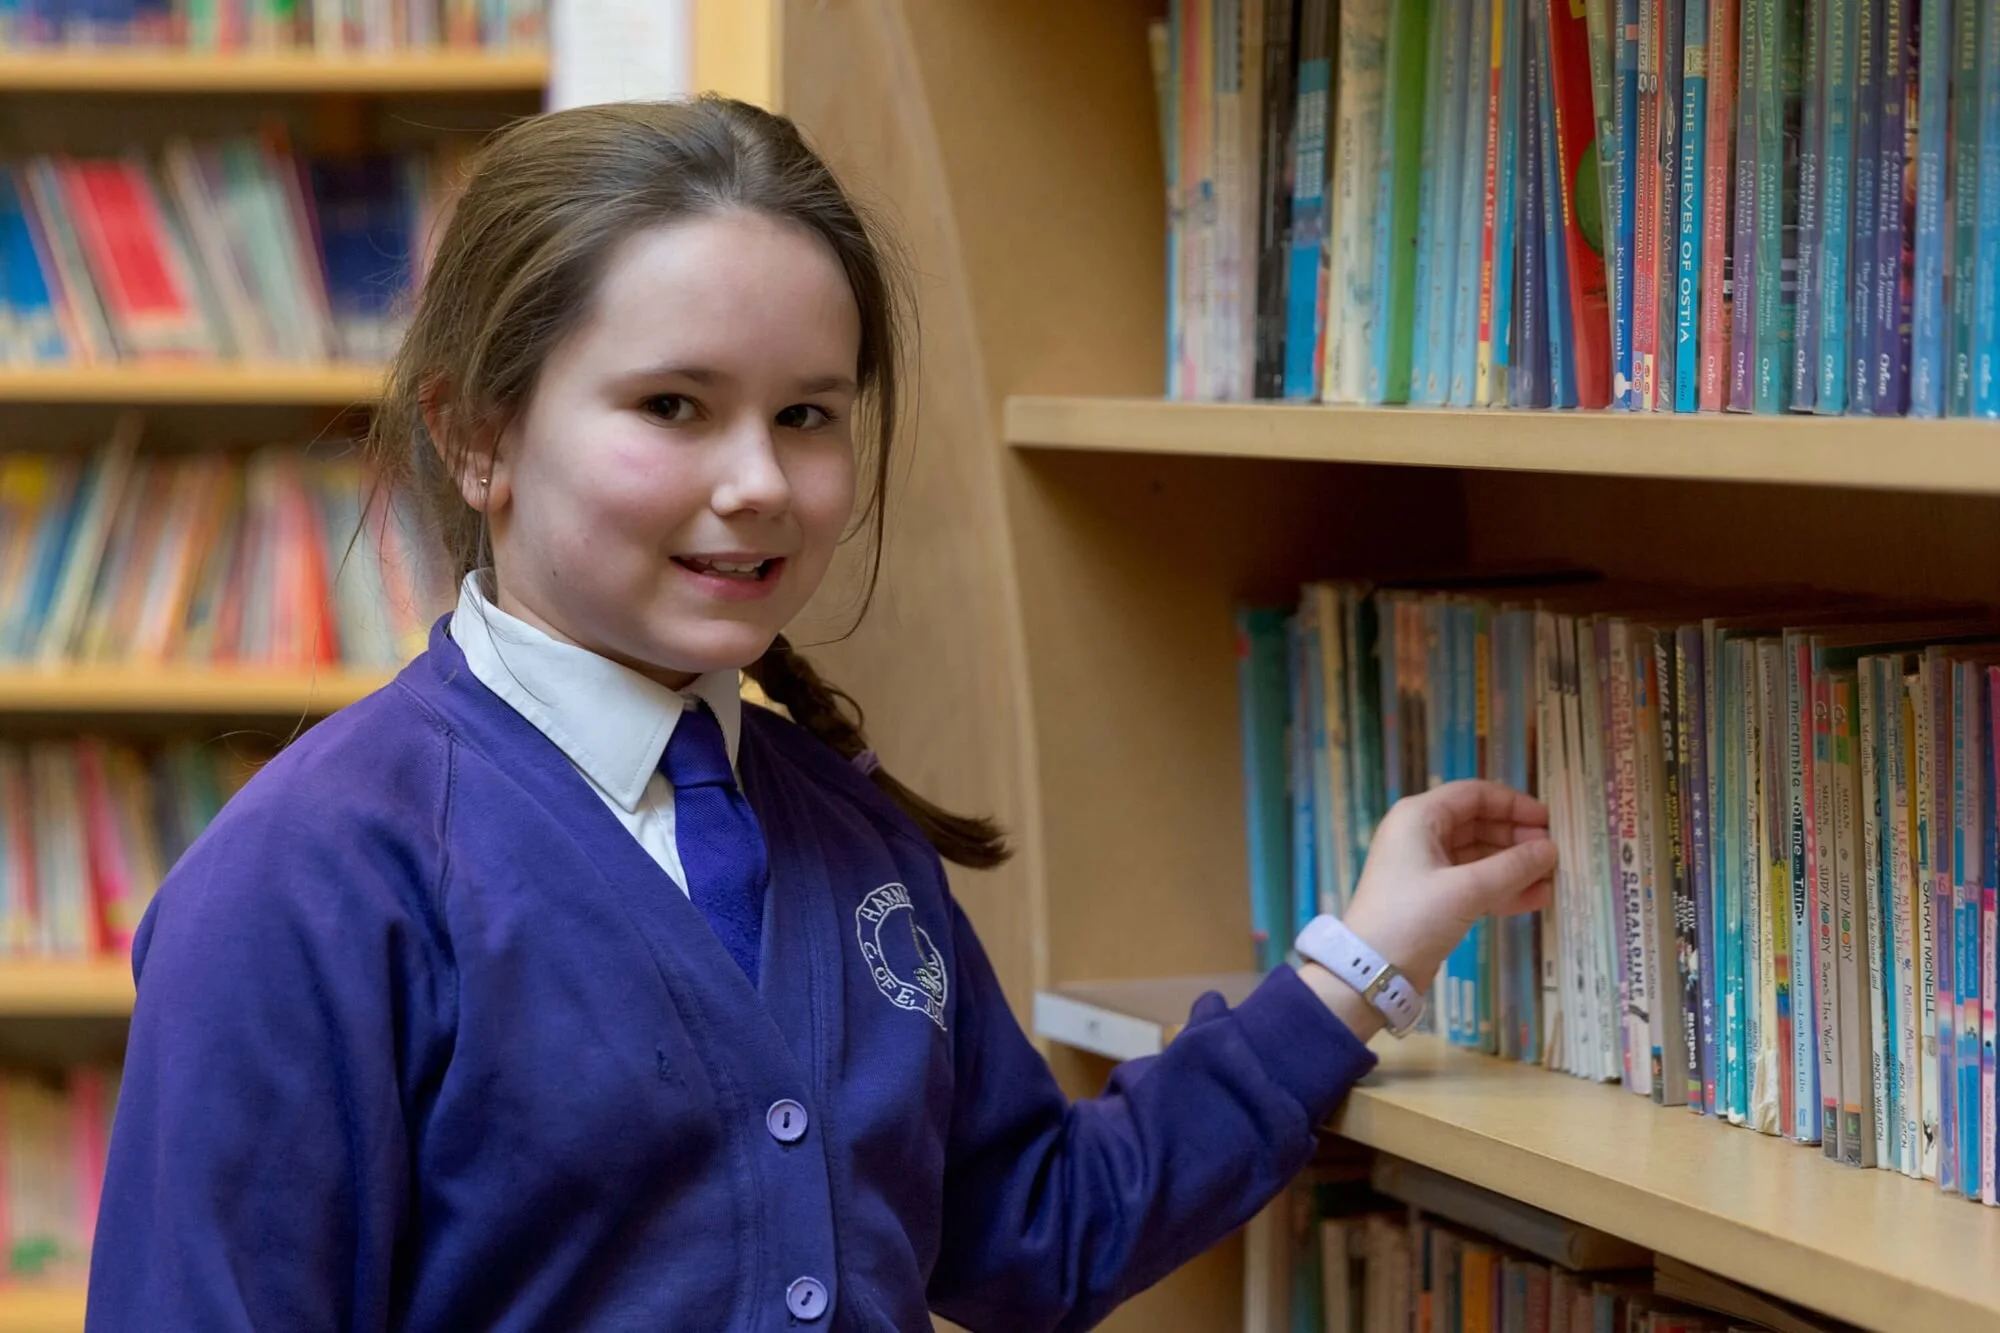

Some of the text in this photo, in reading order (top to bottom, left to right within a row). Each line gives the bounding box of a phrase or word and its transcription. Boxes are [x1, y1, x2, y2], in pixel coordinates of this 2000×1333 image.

[1662, 151, 1675, 227] Waking
[1679, 87, 1695, 344] THE THIEVES OF OSTIA
[1738, 160, 1746, 236] LAWRENCE
[1746, 160, 1754, 236] CAROLINE
[1767, 165, 1776, 240] CAROLINE
[1799, 153, 1808, 232] LAWRENCE
[1806, 153, 1816, 231] CAROLINE
[1833, 156, 1843, 235] CAROLINE
[1856, 158, 1864, 239] LAWRENCE
[1864, 158, 1873, 237] CAROLINE
[1880, 151, 1889, 232] LAWRENCE
[1889, 151, 1899, 231] CAROLINE
[1928, 152, 1938, 232] CAROLINE
[1877, 280, 1886, 320] Jupiter
[1887, 256, 1896, 277] The
[1707, 356, 1715, 394] Orion
[1737, 352, 1745, 392] Orion
[1761, 358, 1770, 397] Orion
[1796, 349, 1806, 390] Orion
[1825, 354, 1834, 396] Orion
[1856, 359, 1865, 400] Orion
[1879, 353, 1890, 396] Orion
[1957, 353, 1968, 397] Orion
[1655, 645, 1673, 762] ANIMAL SOS
[1679, 722, 1688, 764] SOS
[1862, 724, 1871, 776] McCullagh
[1822, 785, 1830, 826] MEGAN
[1891, 826, 1899, 843] The
[1840, 872, 1853, 963] JUDY MOODY
[1864, 820, 1879, 989] The Journey Through The Strange Land
[1893, 894, 1901, 910] The
[1899, 820, 1911, 947] FIERCE MILLY
[1922, 881, 1934, 941] SARAH
[1629, 872, 1643, 997] GERALDINE
[1796, 949, 1804, 987] Legend
[1819, 864, 1832, 997] JUDY MOODY Saves
[874, 966, 897, 991] OF
[1797, 1012, 1805, 1038] Loch
[1799, 1071, 1807, 1092] Lilo
[1873, 1051, 1884, 1142] ARNOLD WHEATON
[1898, 1061, 1908, 1148] ARNOLD WHEATON
